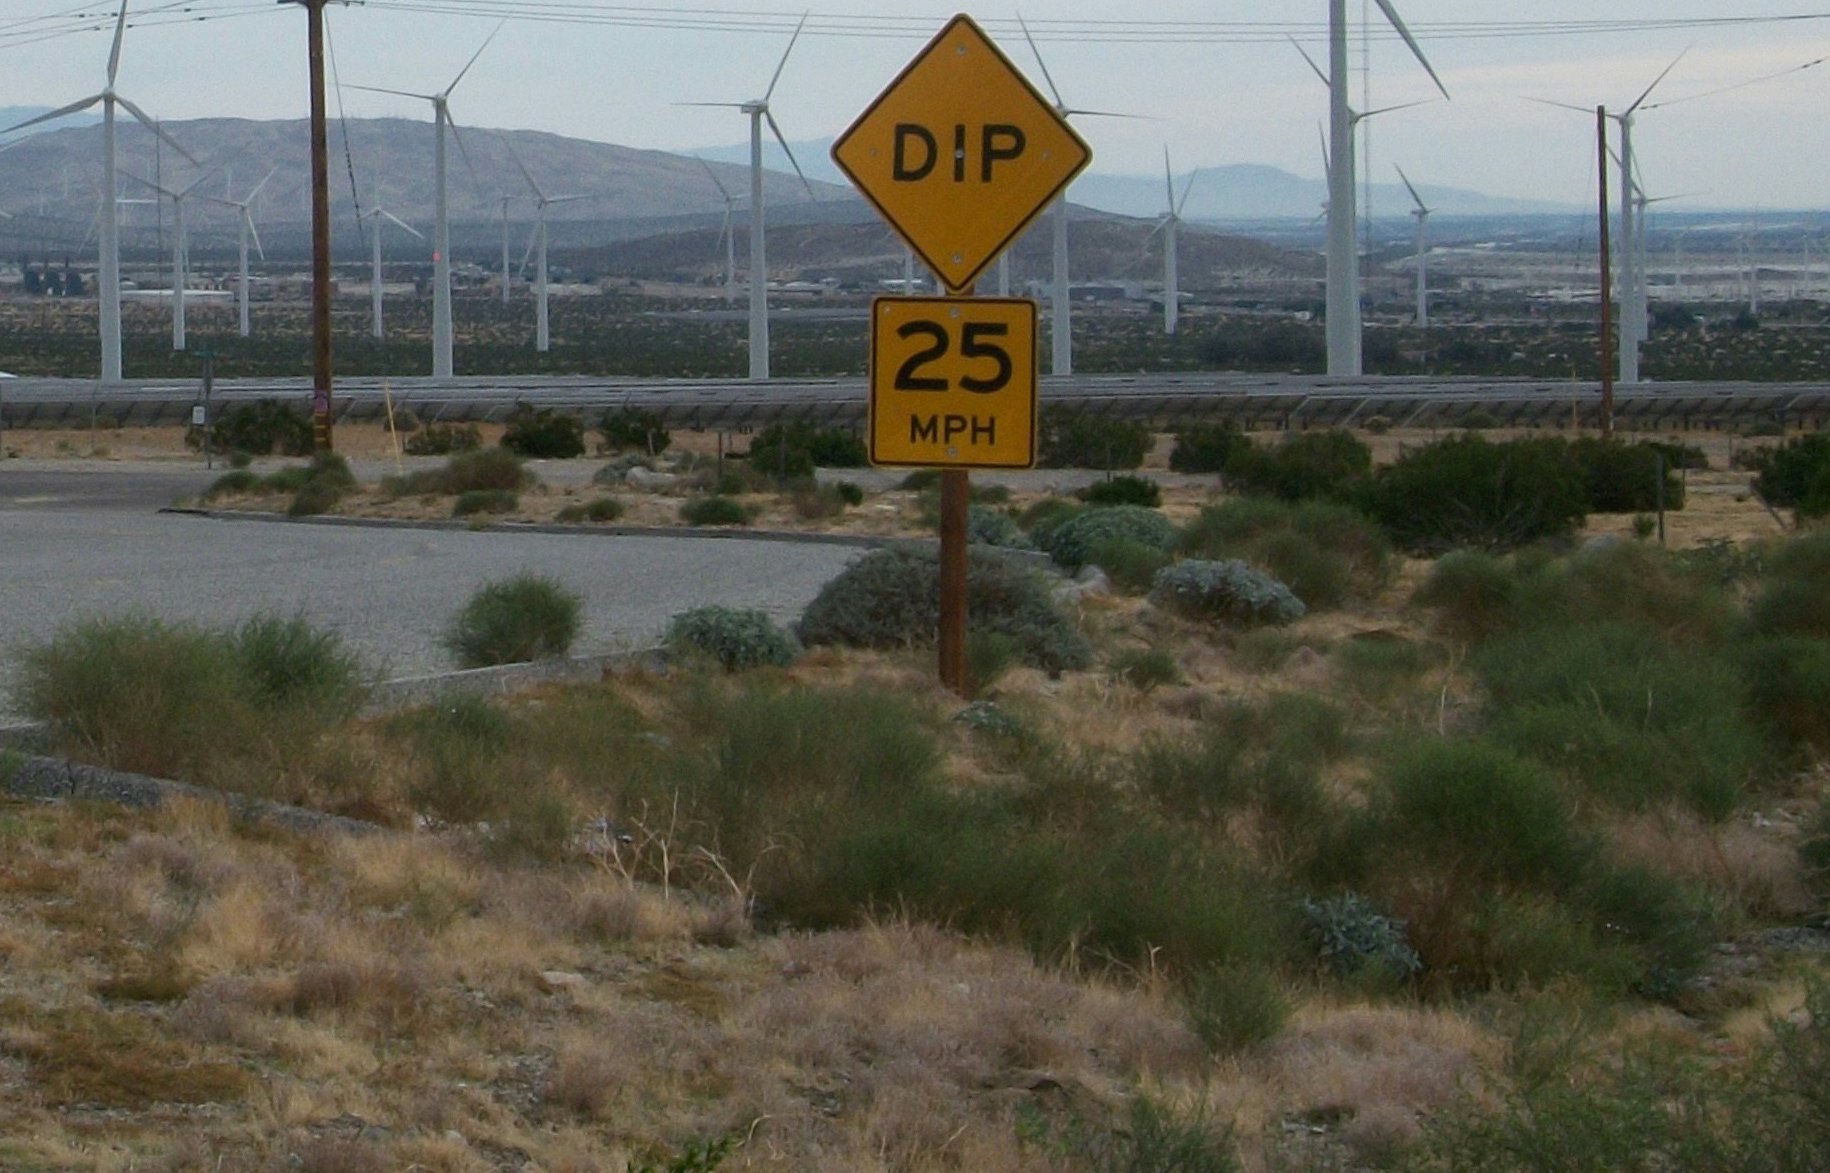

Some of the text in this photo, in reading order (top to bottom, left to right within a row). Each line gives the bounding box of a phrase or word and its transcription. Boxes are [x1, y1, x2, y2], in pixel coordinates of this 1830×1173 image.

[893, 124, 1025, 182] DIP
[895, 320, 1012, 393] 25
[910, 415, 996, 444] MPH
